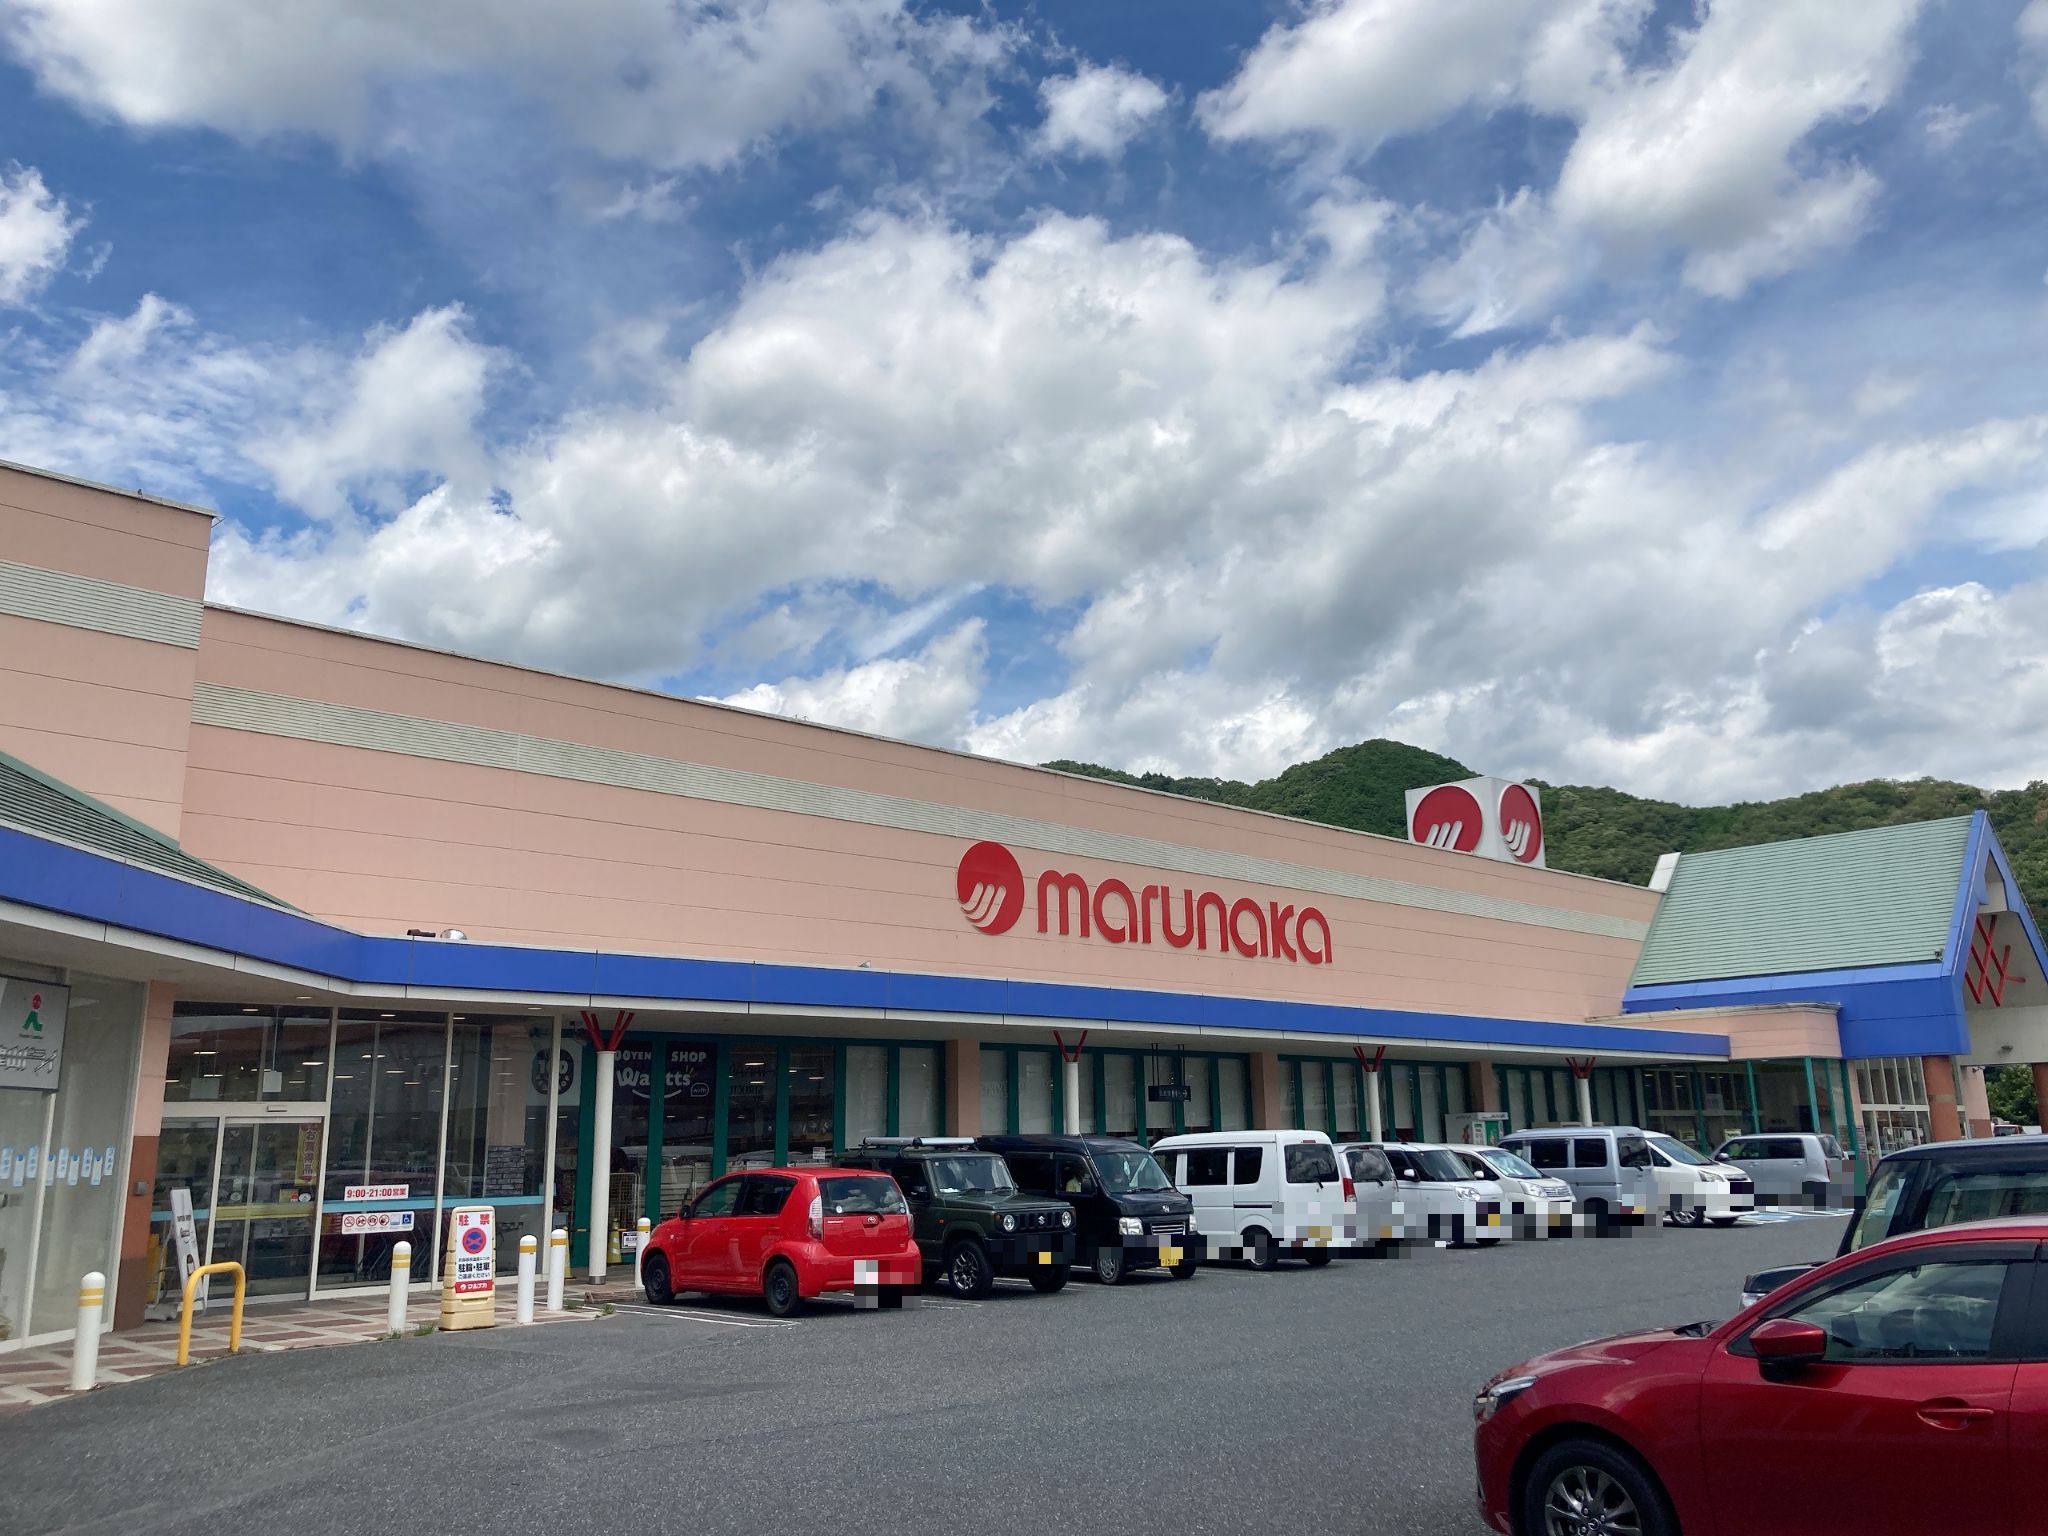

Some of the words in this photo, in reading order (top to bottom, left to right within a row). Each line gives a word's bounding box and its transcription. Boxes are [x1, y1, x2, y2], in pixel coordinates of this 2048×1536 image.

[1036, 869, 1333, 965] marunaka
[614, 1051, 651, 1061] 00YEN
[671, 1051, 706, 1062] SHOP
